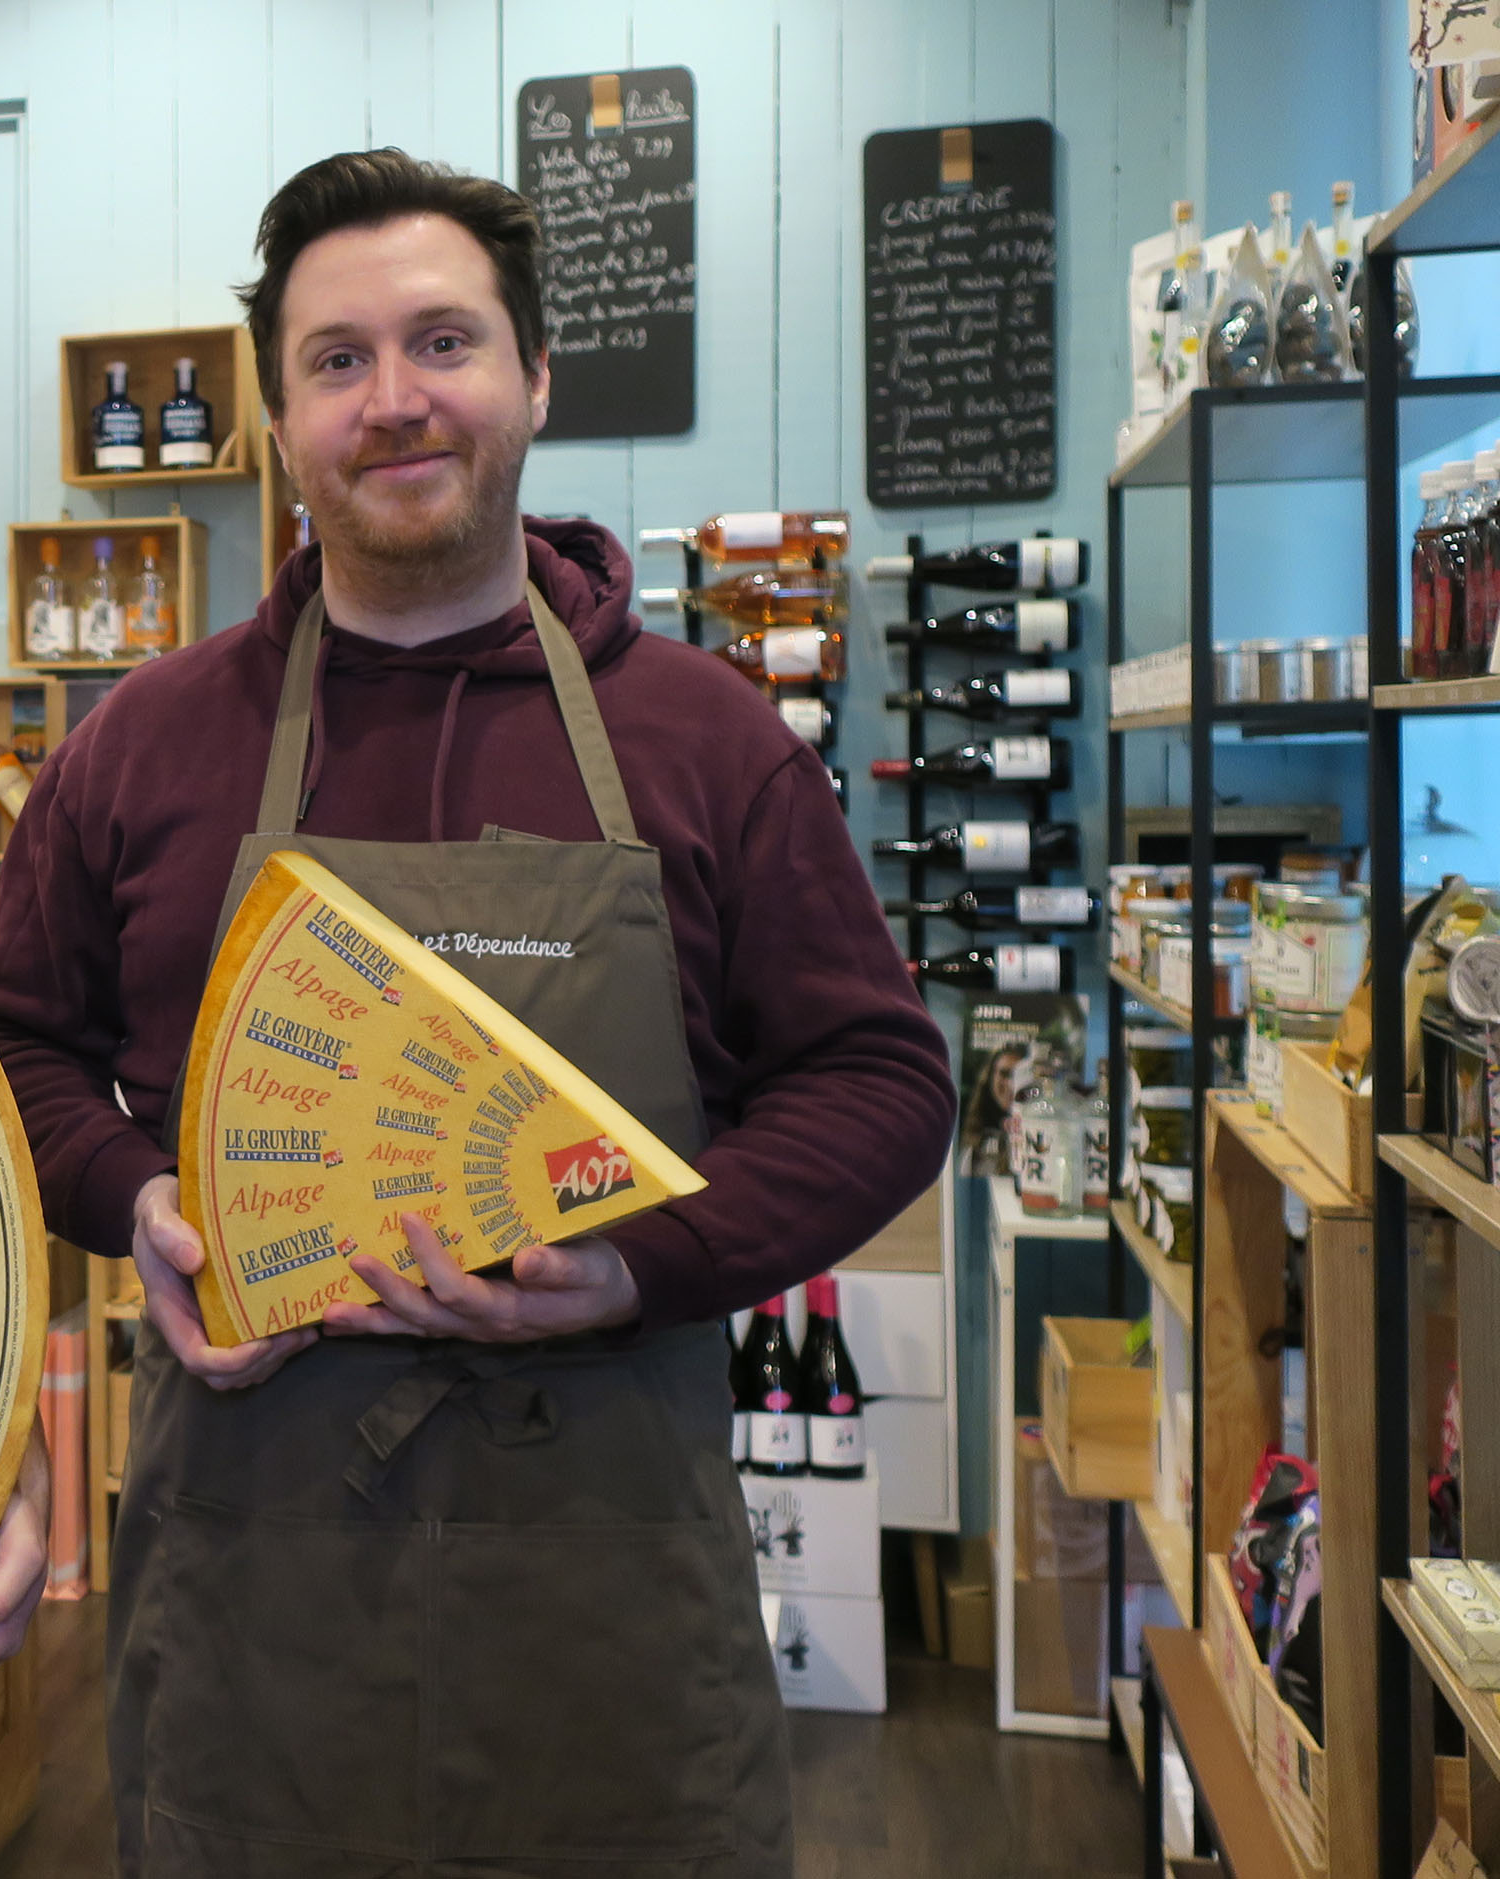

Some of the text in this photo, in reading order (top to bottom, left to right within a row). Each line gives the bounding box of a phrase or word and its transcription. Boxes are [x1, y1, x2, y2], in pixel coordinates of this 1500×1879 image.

[312, 904, 337, 930] LE
[310, 924, 382, 988] SWITZERLAND
[454, 932, 576, 958] Dépendance
[271, 957, 368, 1021] Alpage
[249, 1008, 271, 1031] LE
[250, 1030, 334, 1069] SWITZERLAND
[404, 1039, 419, 1055] LE
[420, 1014, 480, 1063] Alpage
[227, 1067, 331, 1113] Alpage
[380, 1072, 450, 1110] Alpage
[376, 1106, 390, 1119] LE
[225, 1128, 244, 1150] LE
[229, 1152, 317, 1162] SWITZERLAND
[366, 1141, 436, 1167] Alpage
[372, 1179, 386, 1192] LE
[551, 1152, 630, 1200] AOP
[226, 1183, 325, 1219] Alpage
[237, 1252, 260, 1274] LE
[249, 1249, 333, 1283] SWITZERLAND
[391, 1250, 404, 1265] LE
